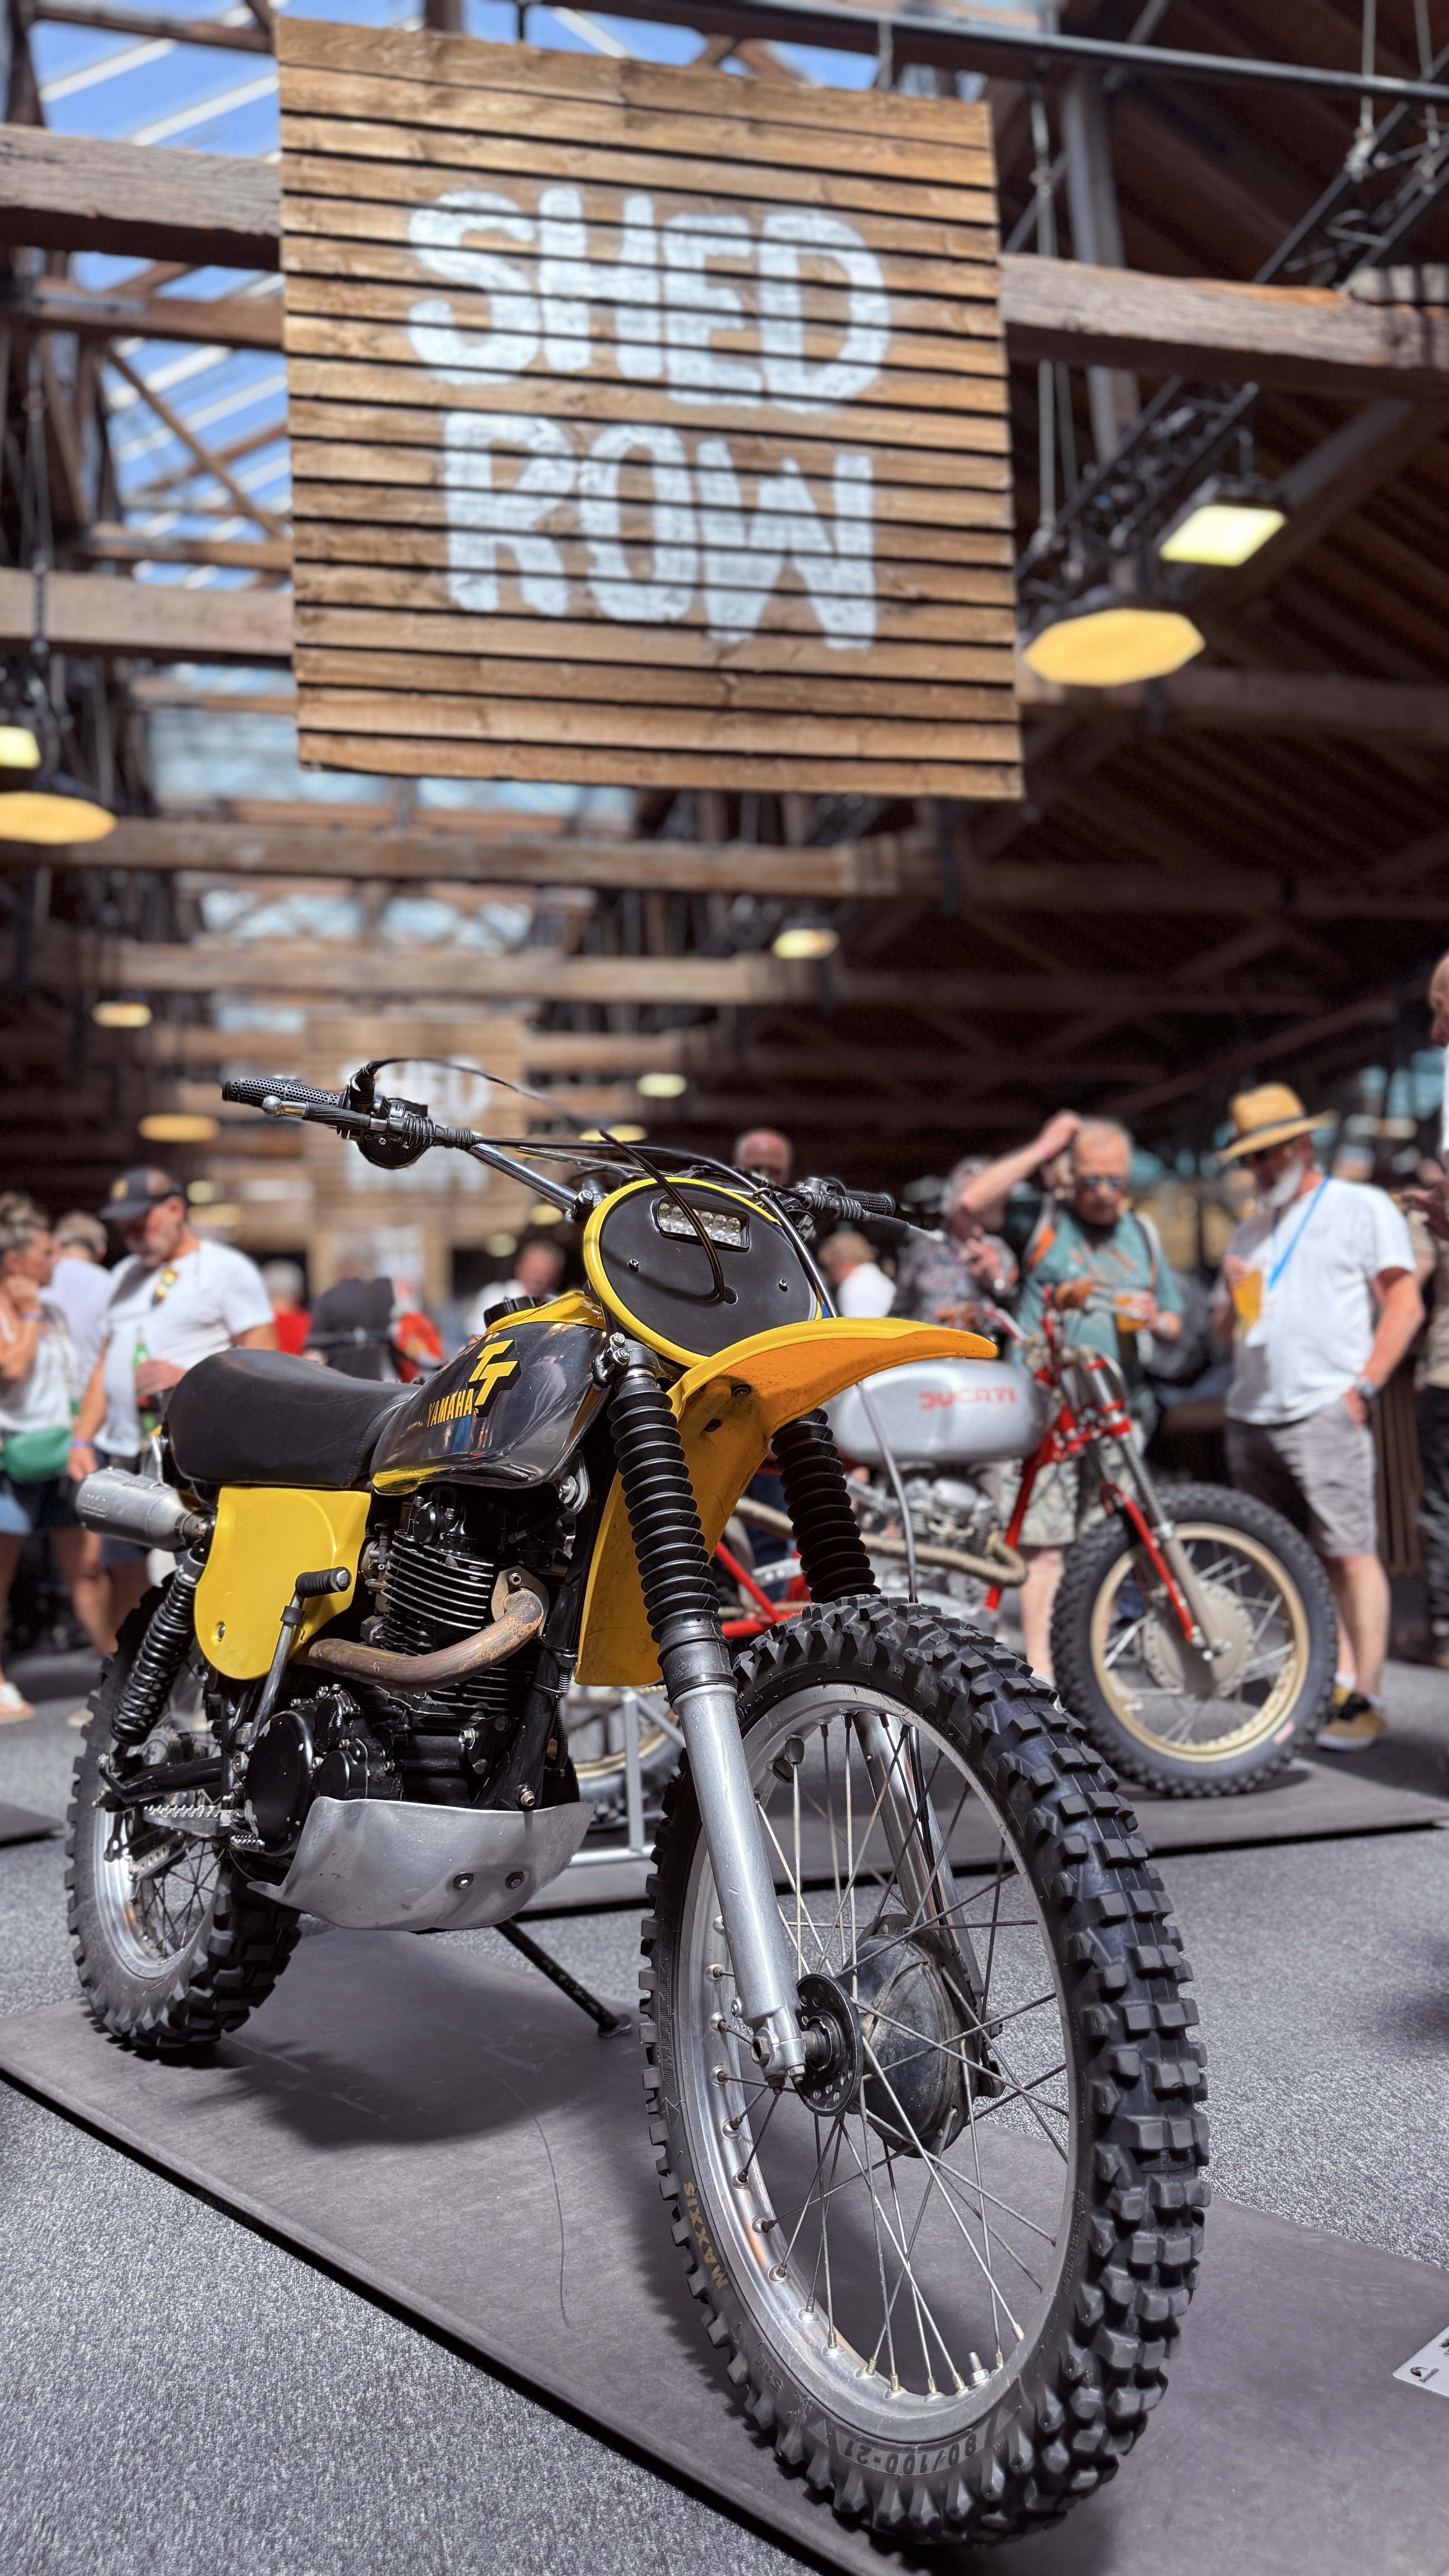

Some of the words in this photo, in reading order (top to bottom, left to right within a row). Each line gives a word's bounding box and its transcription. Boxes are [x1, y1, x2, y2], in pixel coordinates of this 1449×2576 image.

[407, 186, 892, 414] SHED
[443, 409, 877, 652] ROW
[468, 1339, 519, 1406] TT
[917, 1386, 1017, 1411] DUCATI
[426, 1388, 474, 1429] YAMAHA
[683, 2181, 729, 2289] MAXXIS
[844, 2434, 977, 2475] 80/100-21
